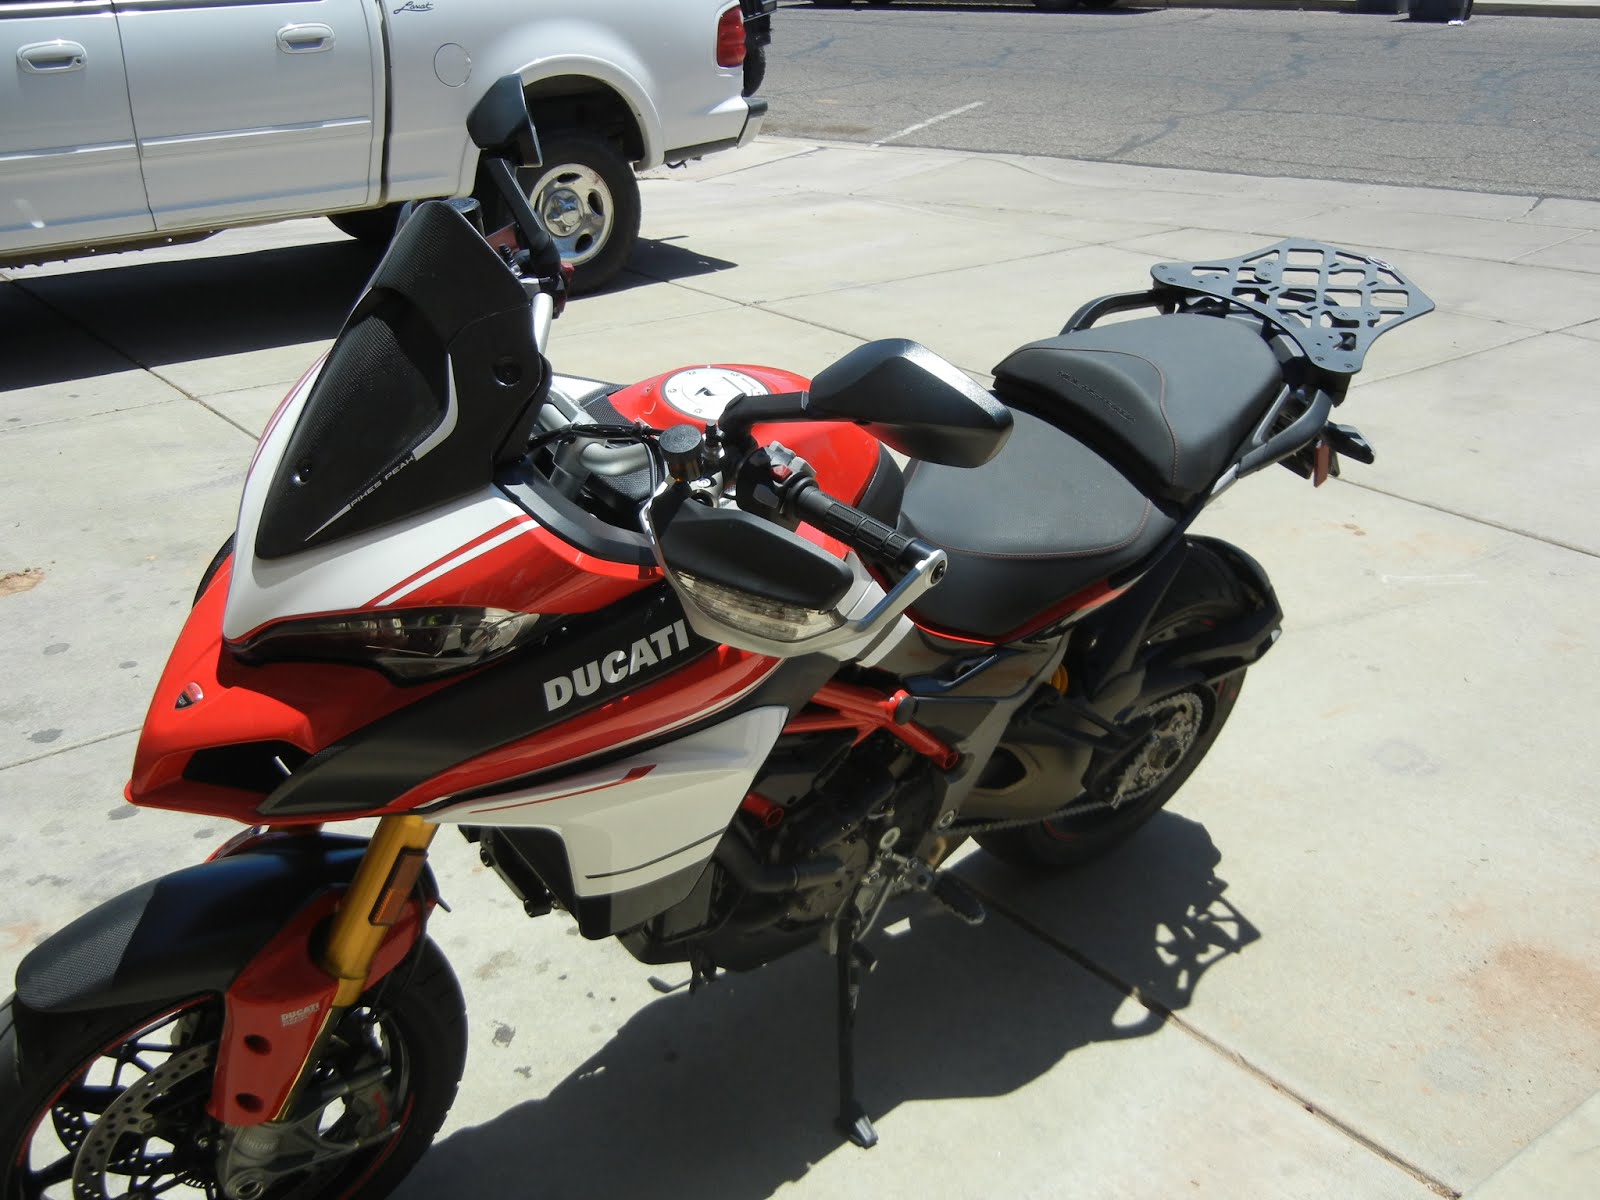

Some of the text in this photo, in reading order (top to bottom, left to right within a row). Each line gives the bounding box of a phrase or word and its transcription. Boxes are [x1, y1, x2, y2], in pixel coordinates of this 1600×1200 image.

[350, 455, 414, 507] PIKES PEAK
[543, 618, 690, 712] DUCATI
[281, 1002, 320, 1022] DUCATI
